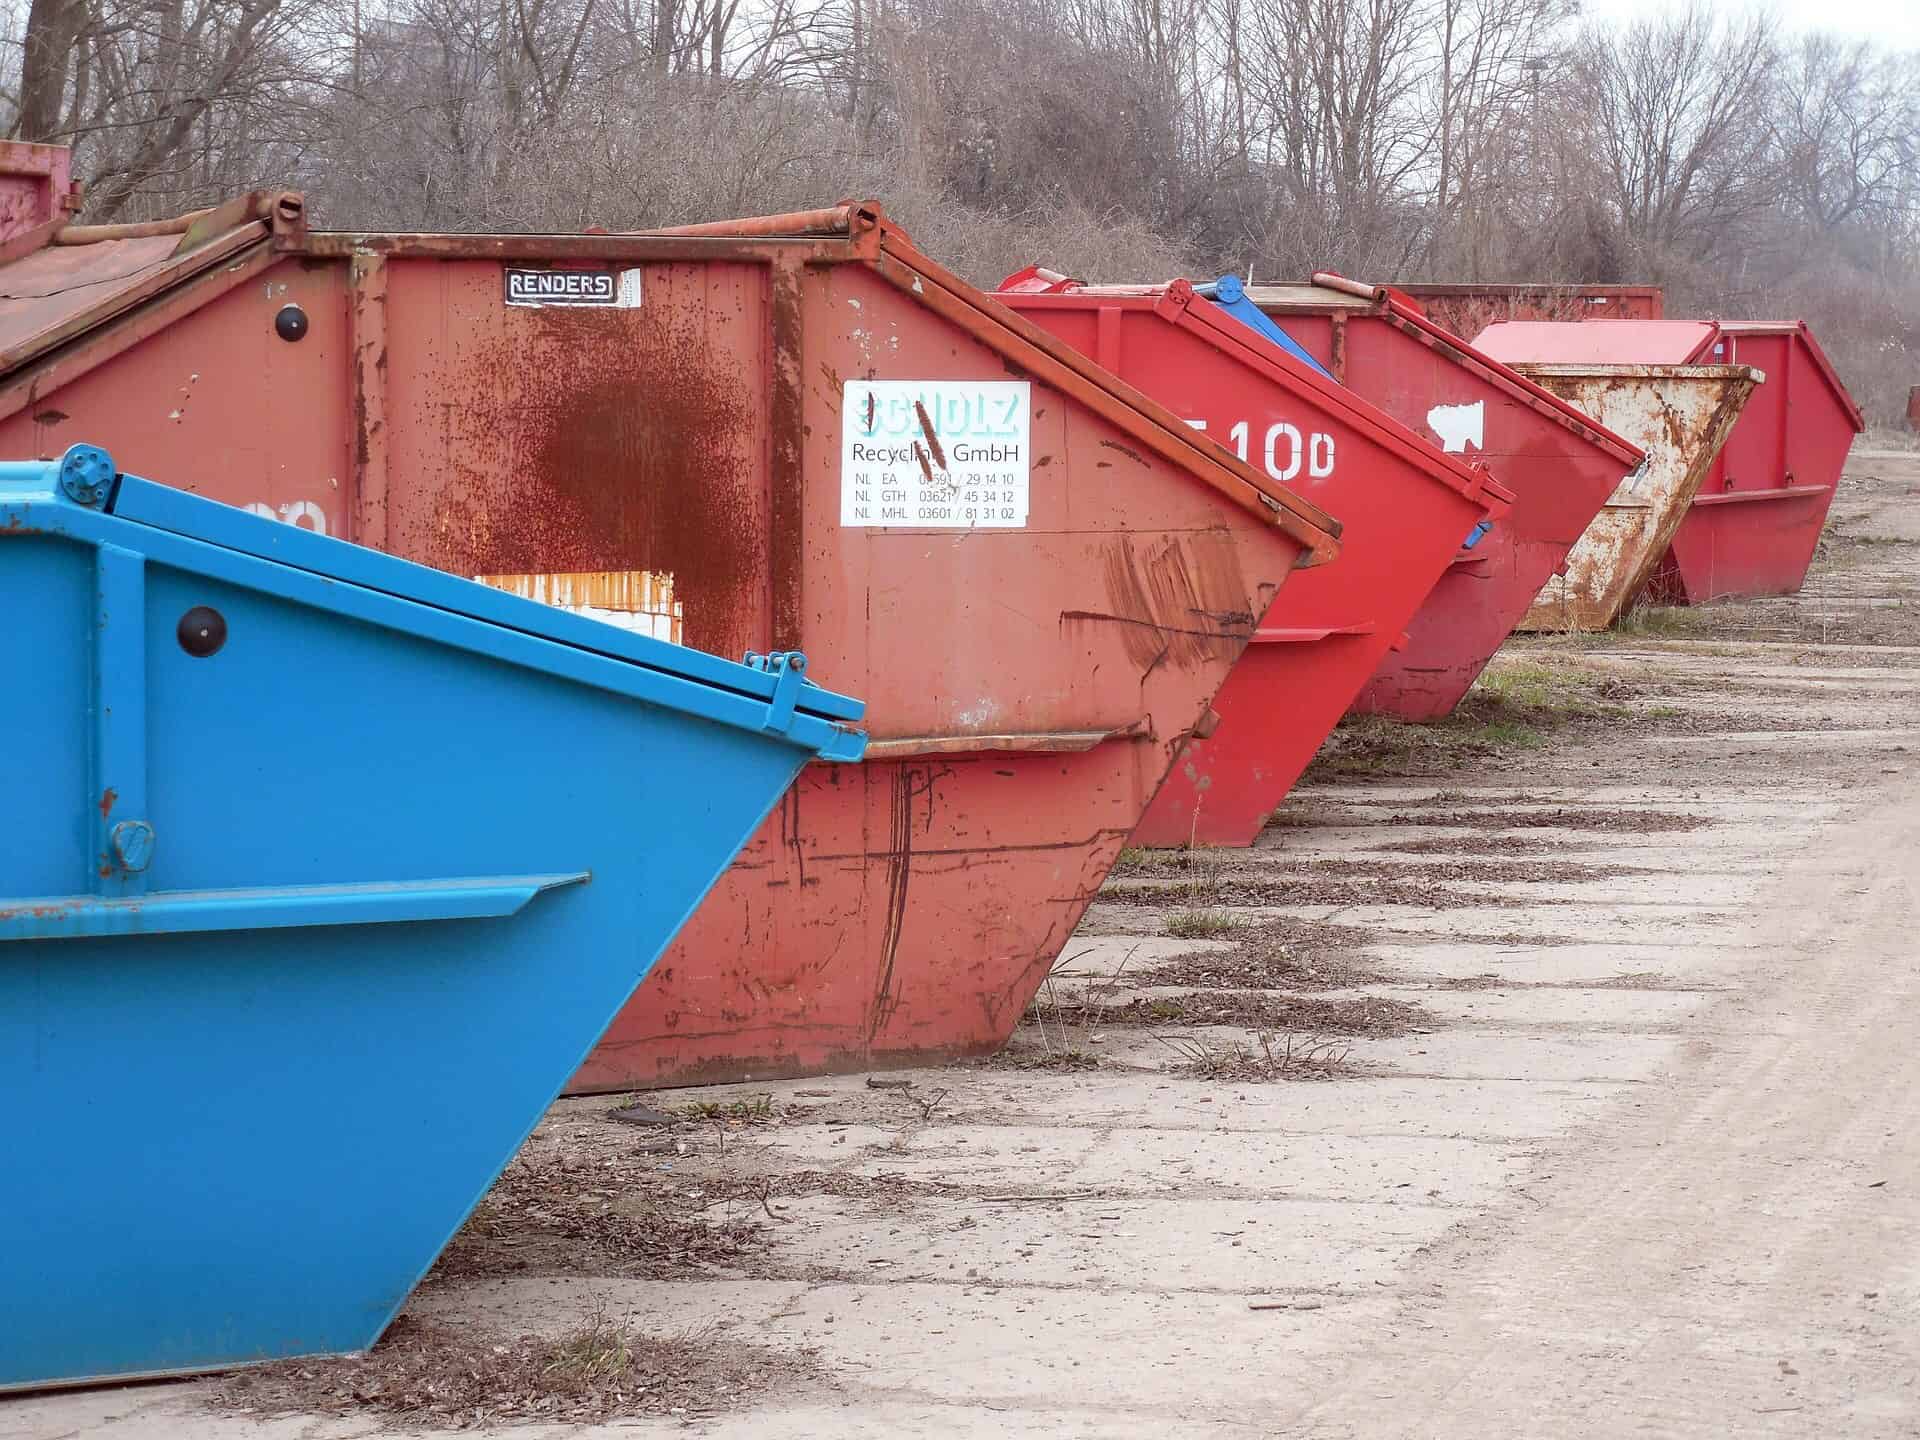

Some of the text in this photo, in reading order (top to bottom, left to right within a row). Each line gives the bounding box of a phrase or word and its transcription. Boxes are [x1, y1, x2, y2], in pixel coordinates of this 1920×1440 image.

[510, 274, 608, 293] RENDERS
[953, 443, 1019, 462] GmbH
[855, 472, 871, 485] NL
[882, 472, 898, 485] EA
[966, 473, 981, 485] 29
[985, 473, 997, 485] 14
[1002, 473, 1014, 485] 10
[855, 489, 871, 502] NL
[881, 490, 906, 502] GTH
[919, 490, 952, 503] 03621
[964, 490, 979, 503] 45
[983, 490, 996, 503] 34
[1002, 490, 1014, 503] 12
[855, 507, 871, 519] NL
[881, 507, 909, 519] MHL
[918, 507, 952, 519] 03601
[965, 507, 977, 519] 81
[983, 507, 995, 519] 31
[1001, 507, 1015, 519] 02
